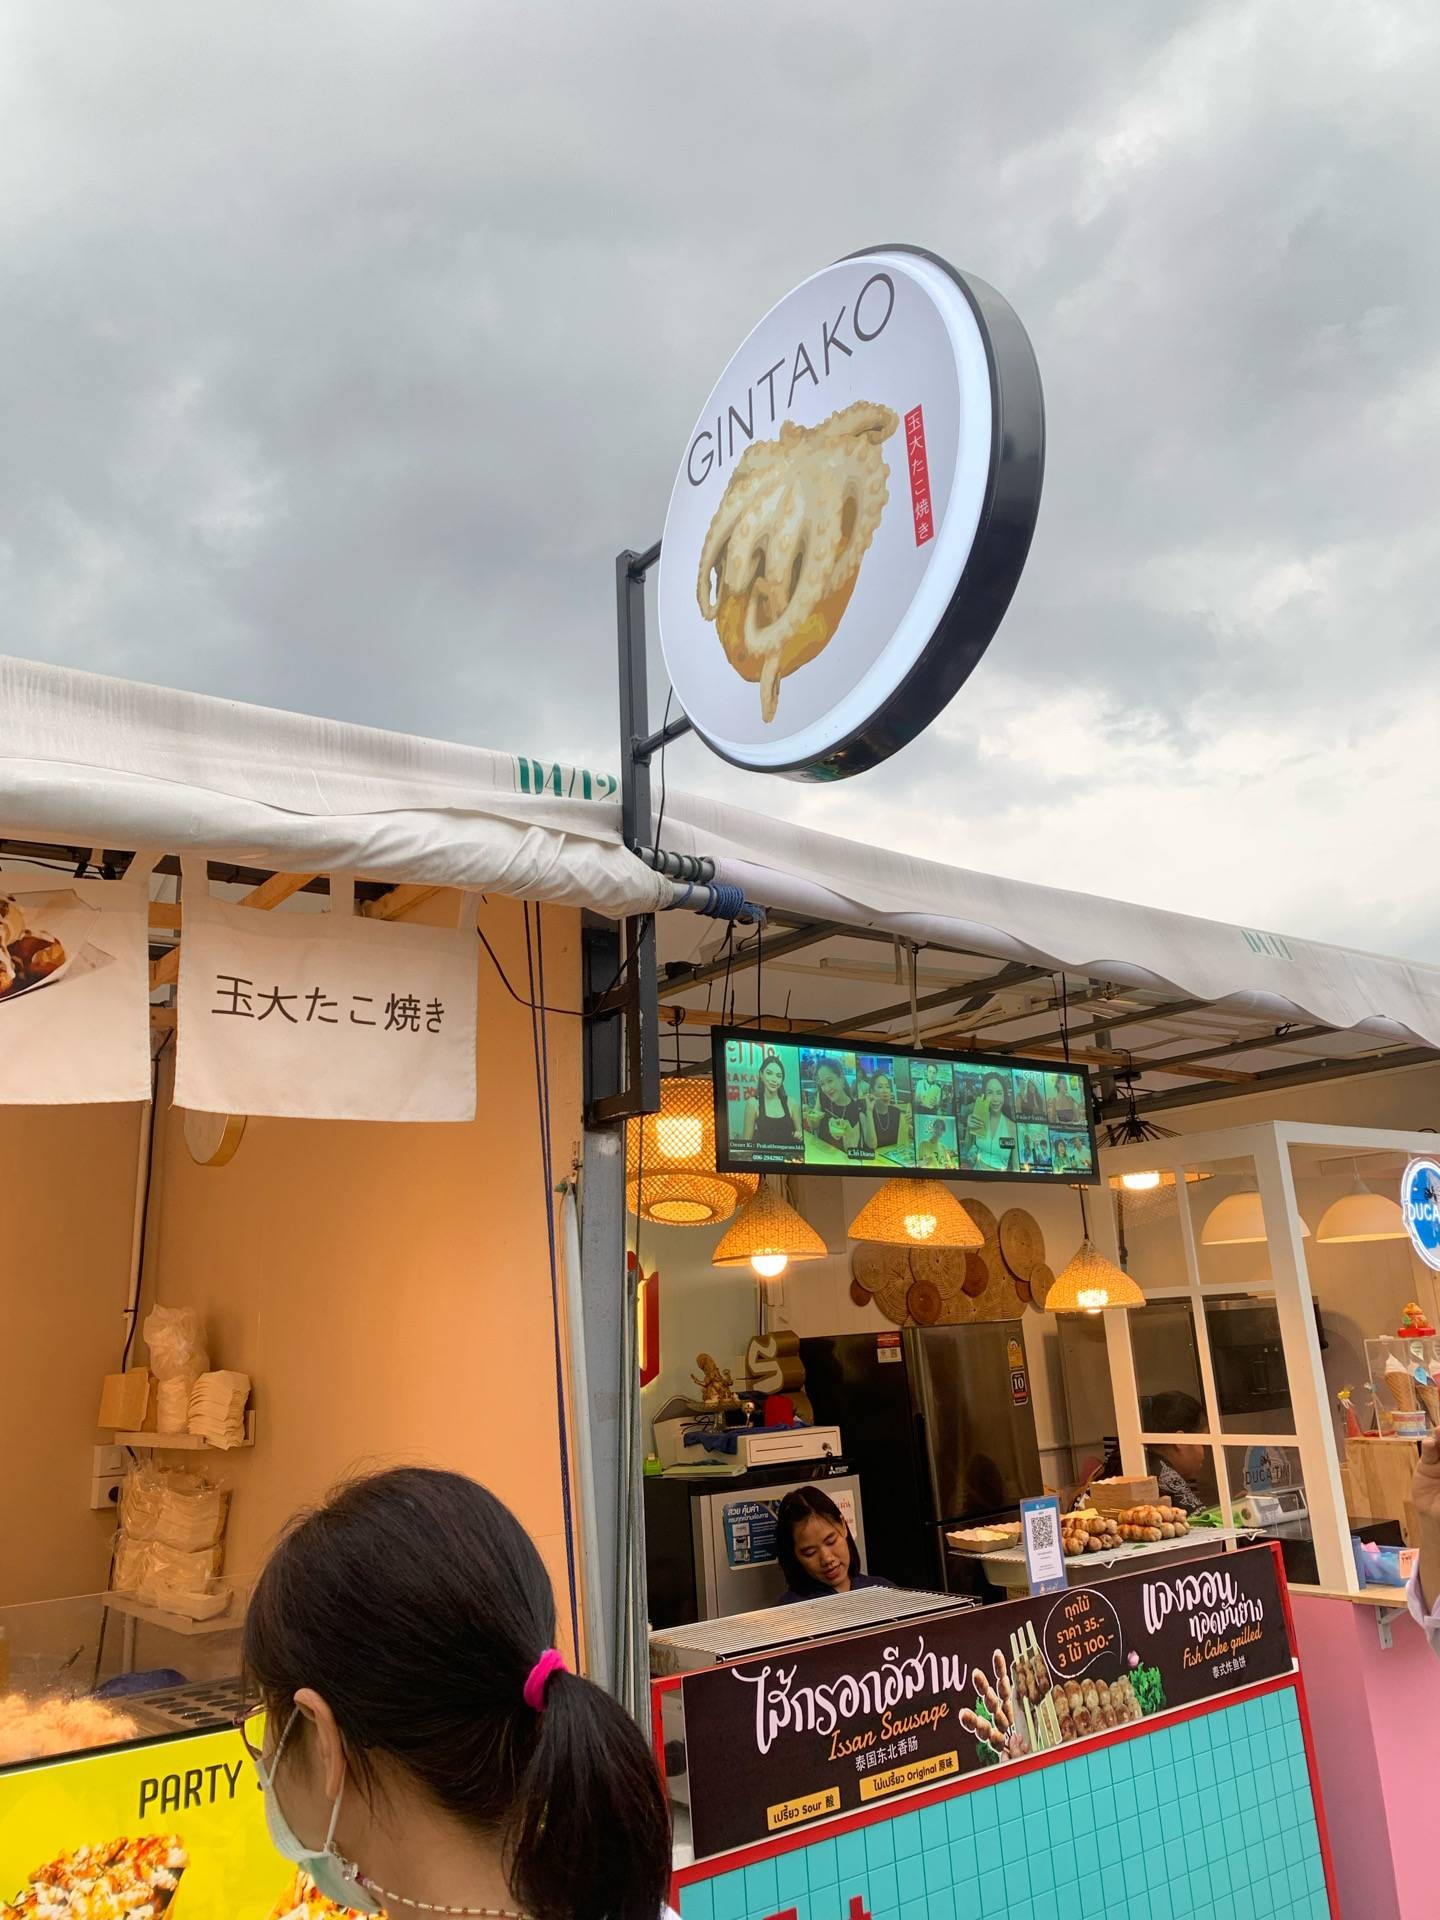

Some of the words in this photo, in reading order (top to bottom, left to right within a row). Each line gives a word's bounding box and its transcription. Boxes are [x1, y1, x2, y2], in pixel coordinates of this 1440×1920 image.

[687, 272, 896, 487] GINTAKO
[907, 411, 930, 540] 玉大たこ焼き
[211, 974, 446, 1034] 玉大たこ焼き
[1013, 1377, 1025, 1390] 10
[1064, 1594, 1091, 1622] ทุกไม้
[1142, 1571, 1238, 1635] แจงลอน
[1189, 1592, 1264, 1643] ทอดมันย่าง
[1056, 1624, 1082, 1644] ราคา
[1083, 1617, 1105, 1633] 35.-
[1058, 1653, 1067, 1668] 3
[1066, 1641, 1082, 1662] ไม้
[1083, 1634, 1114, 1655] 100.-
[1183, 1646, 1203, 1670] Fish
[1204, 1637, 1229, 1660] Cake
[1230, 1621, 1263, 1657] grilled
[731, 1635, 968, 1755] ไส้กรอกอีสาน
[828, 1729, 878, 1761] Issan
[880, 1702, 950, 1740] Sausage
[855, 1735, 919, 1773] 泰国东北香肠
[139, 1760, 243, 1819] PARTY
[873, 1771, 906, 1792] ไม่เปรี้ยว
[906, 1764, 938, 1781] Original
[773, 1804, 800, 1824] เปรี้ยว
[802, 1801, 823, 1815] Sour
